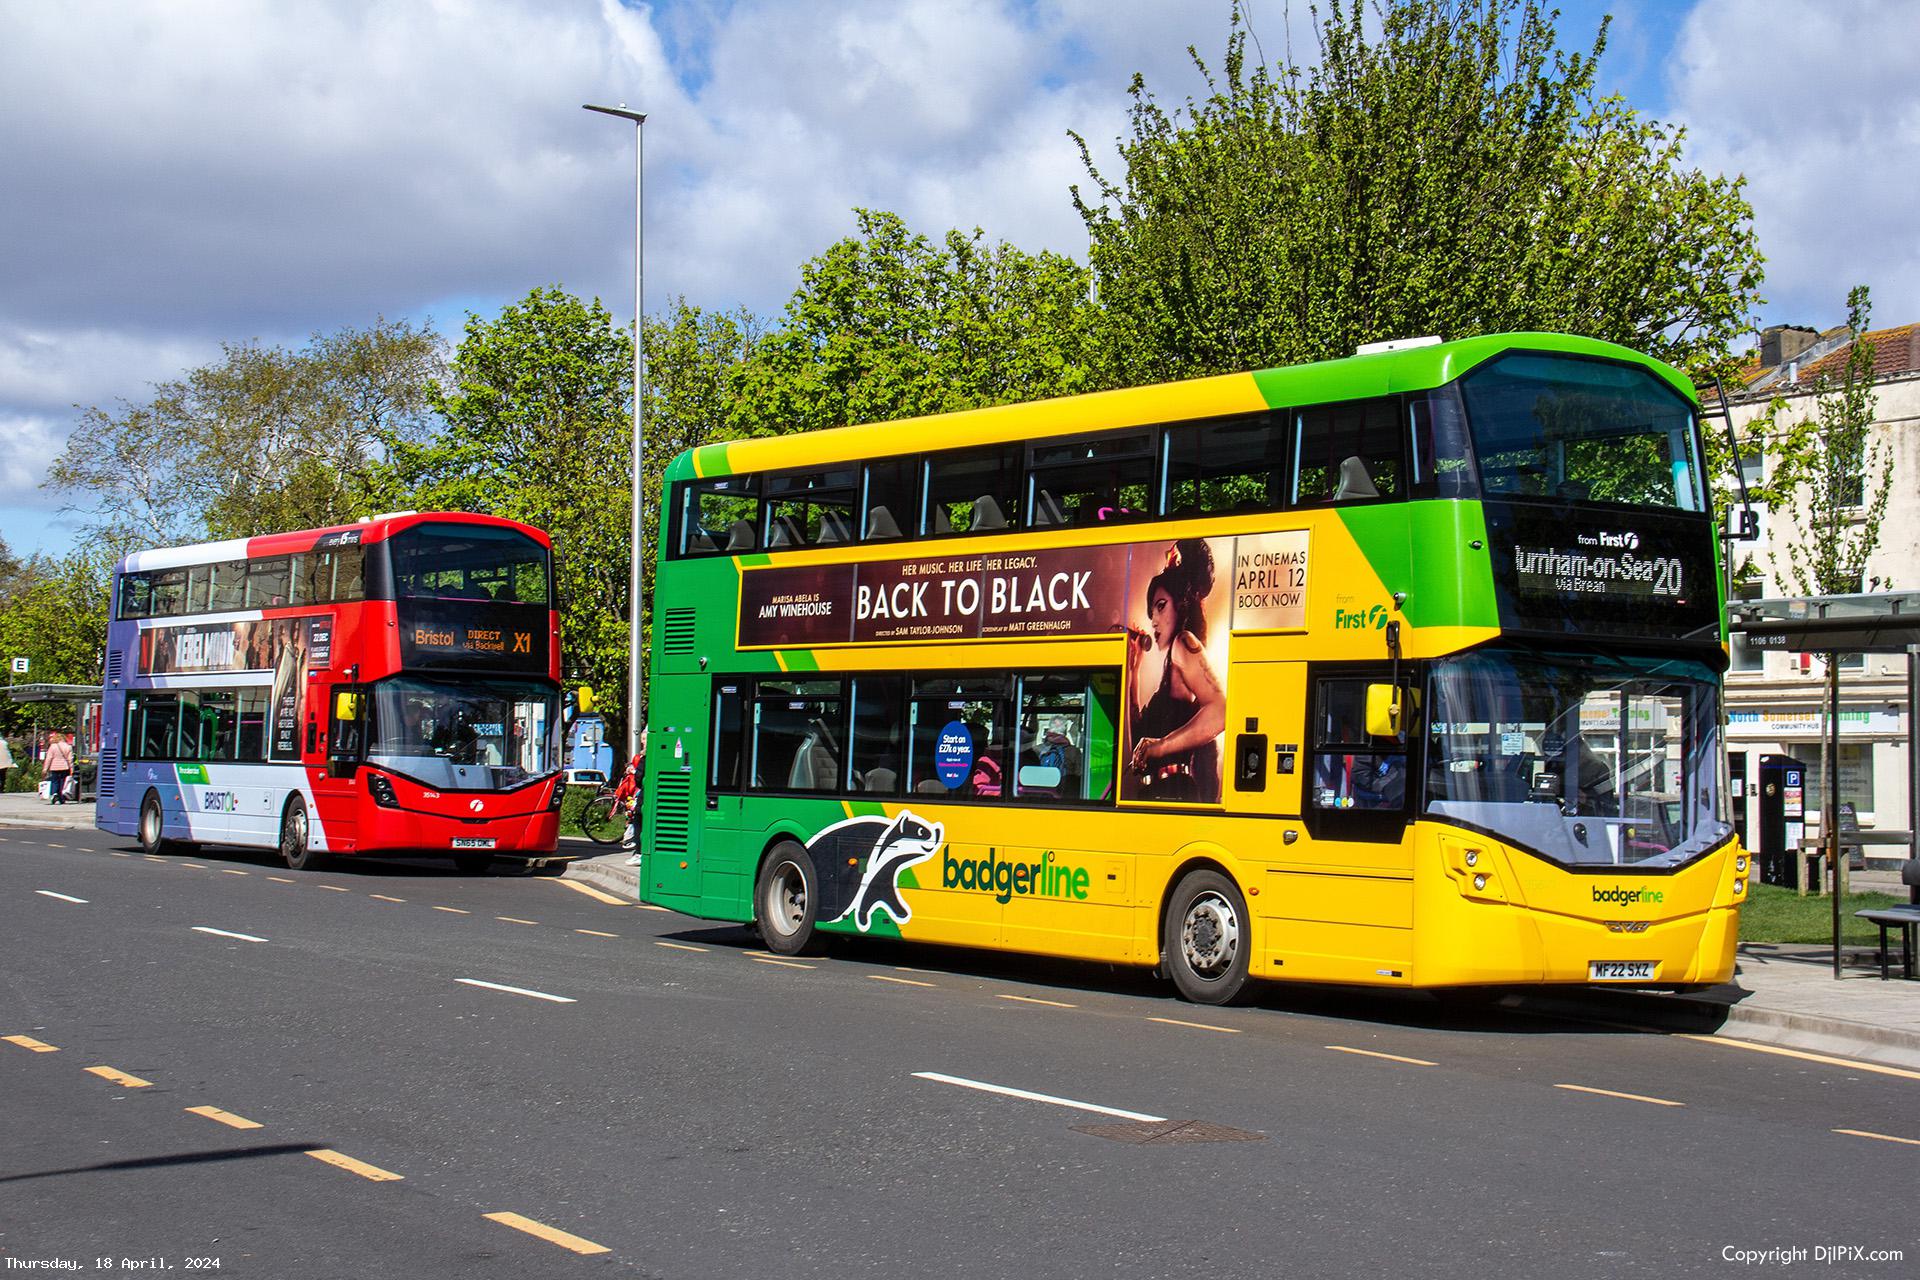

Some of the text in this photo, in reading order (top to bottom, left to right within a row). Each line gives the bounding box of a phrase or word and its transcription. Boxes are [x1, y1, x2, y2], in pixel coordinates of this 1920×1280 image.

[1740, 510, 1760, 541] B
[1577, 532, 1625, 547] from First
[902, 556, 1038, 576] HER MUSIC. HER LIFE. HER LEGACY.
[1237, 551, 1306, 568] IN CINEMAS
[1236, 567, 1305, 590] APRIL 12
[1653, 557, 1683, 596] 20
[1574, 577, 1606, 593] Brean
[772, 593, 820, 604] MARISA ABELA IS
[857, 571, 1092, 620] BACK TO BLACK
[1238, 592, 1301, 608] BOOK NOW
[758, 601, 832, 619] AMY WINEHOUSE
[1008, 623, 1025, 632] MATT
[1026, 621, 1071, 631] GREENHALGH
[1336, 609, 1366, 629] First
[415, 629, 454, 646] Bristol
[467, 629, 501, 641] DIRECT
[895, 627, 909, 636] SAM
[909, 625, 963, 635] TAYLOR-JOHNSON
[512, 632, 531, 653] X1
[16, 660, 25, 670] E
[1729, 711, 1759, 724] North
[1763, 710, 1815, 722] Somerset
[1771, 723, 1806, 731] COMMUNITY
[943, 734, 958, 744] Start
[1790, 773, 1797, 783] P
[204, 791, 236, 812] BRISTOL
[943, 844, 1090, 905] badgerline
[1592, 885, 1664, 907] badgerline
[1595, 963, 1649, 977] MF22 SXZ
